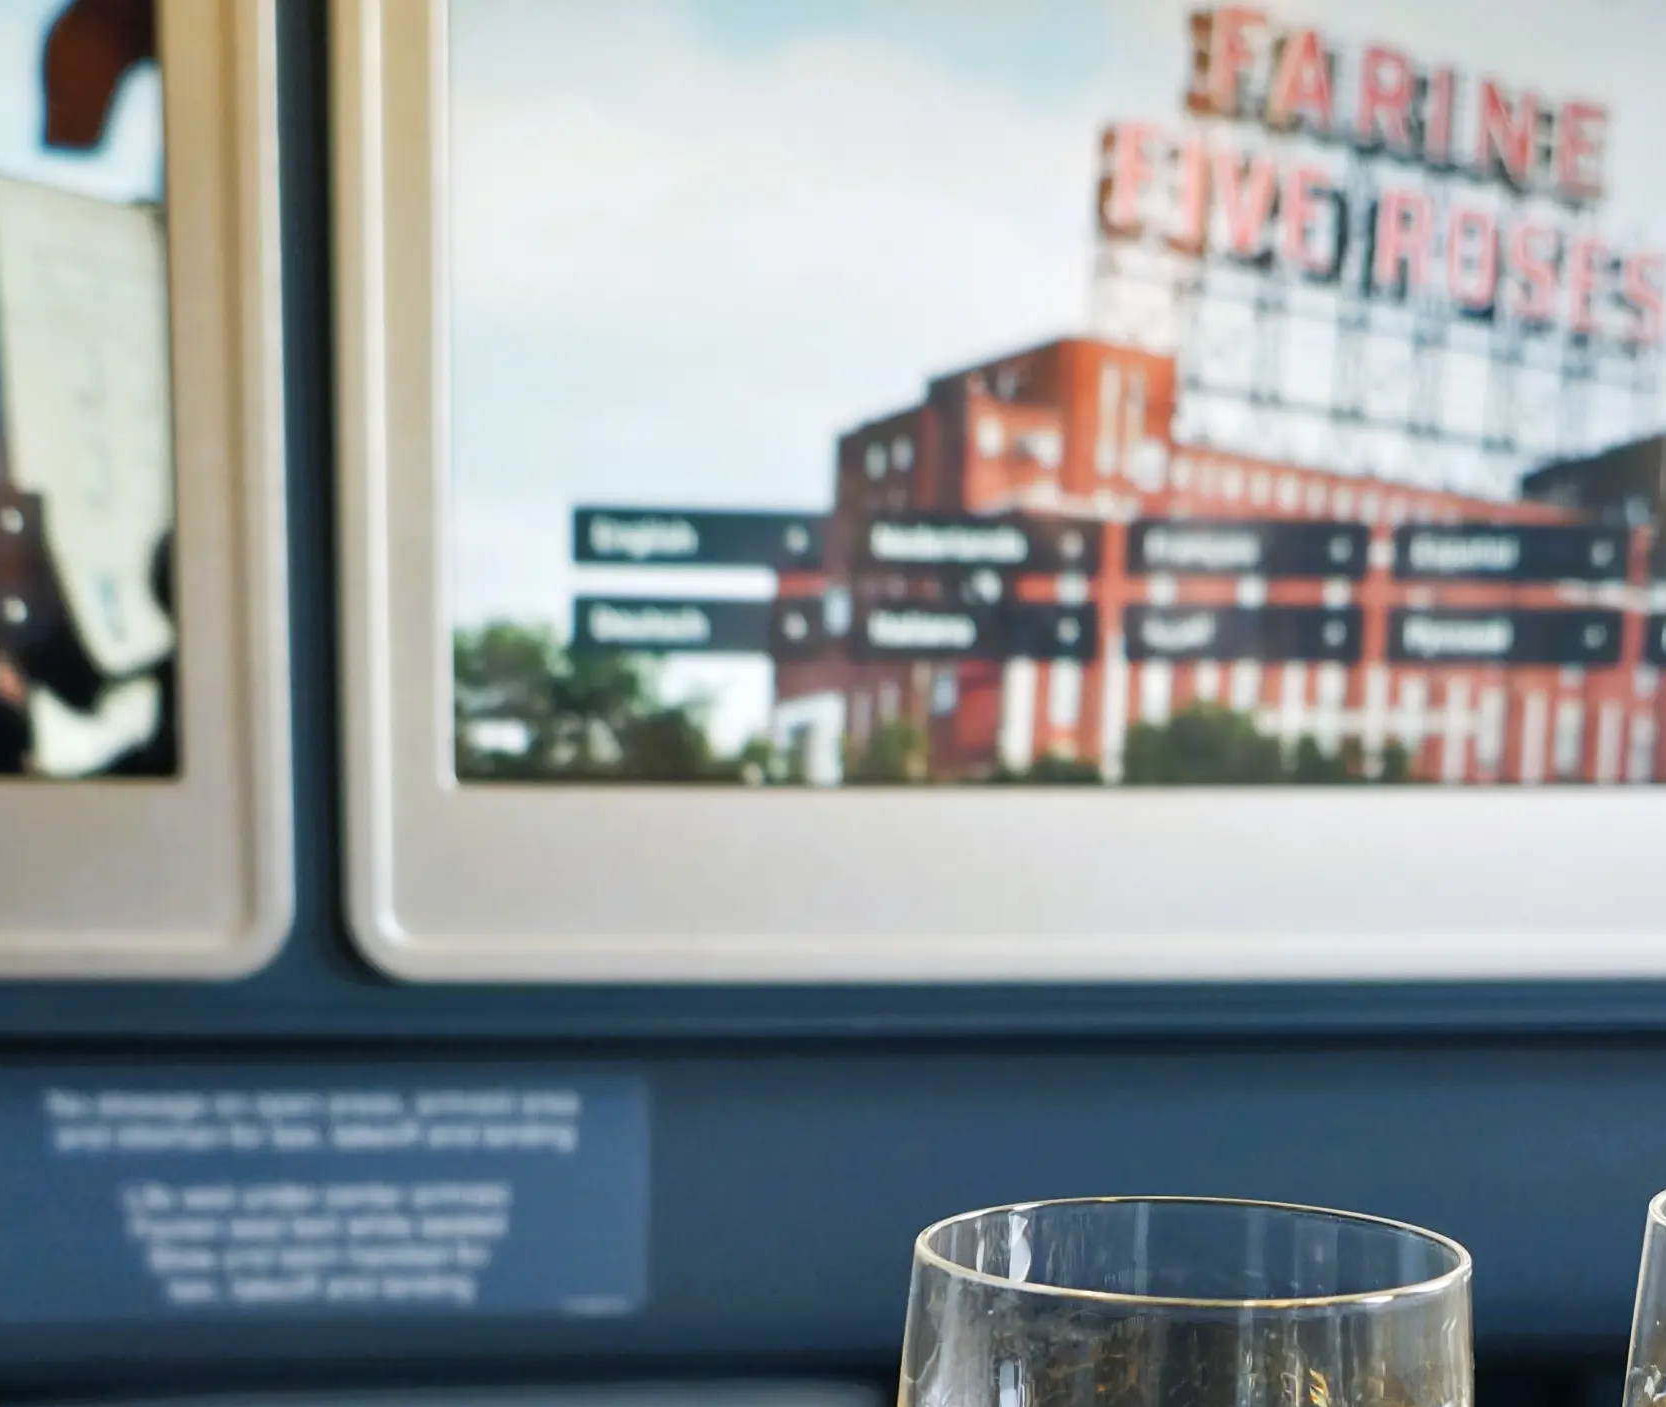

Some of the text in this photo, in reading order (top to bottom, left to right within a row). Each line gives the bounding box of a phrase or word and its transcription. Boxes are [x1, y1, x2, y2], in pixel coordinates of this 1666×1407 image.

[1193, 5, 1613, 205] FARINE
[1103, 118, 1341, 285] FIVE
[588, 514, 700, 558] English
